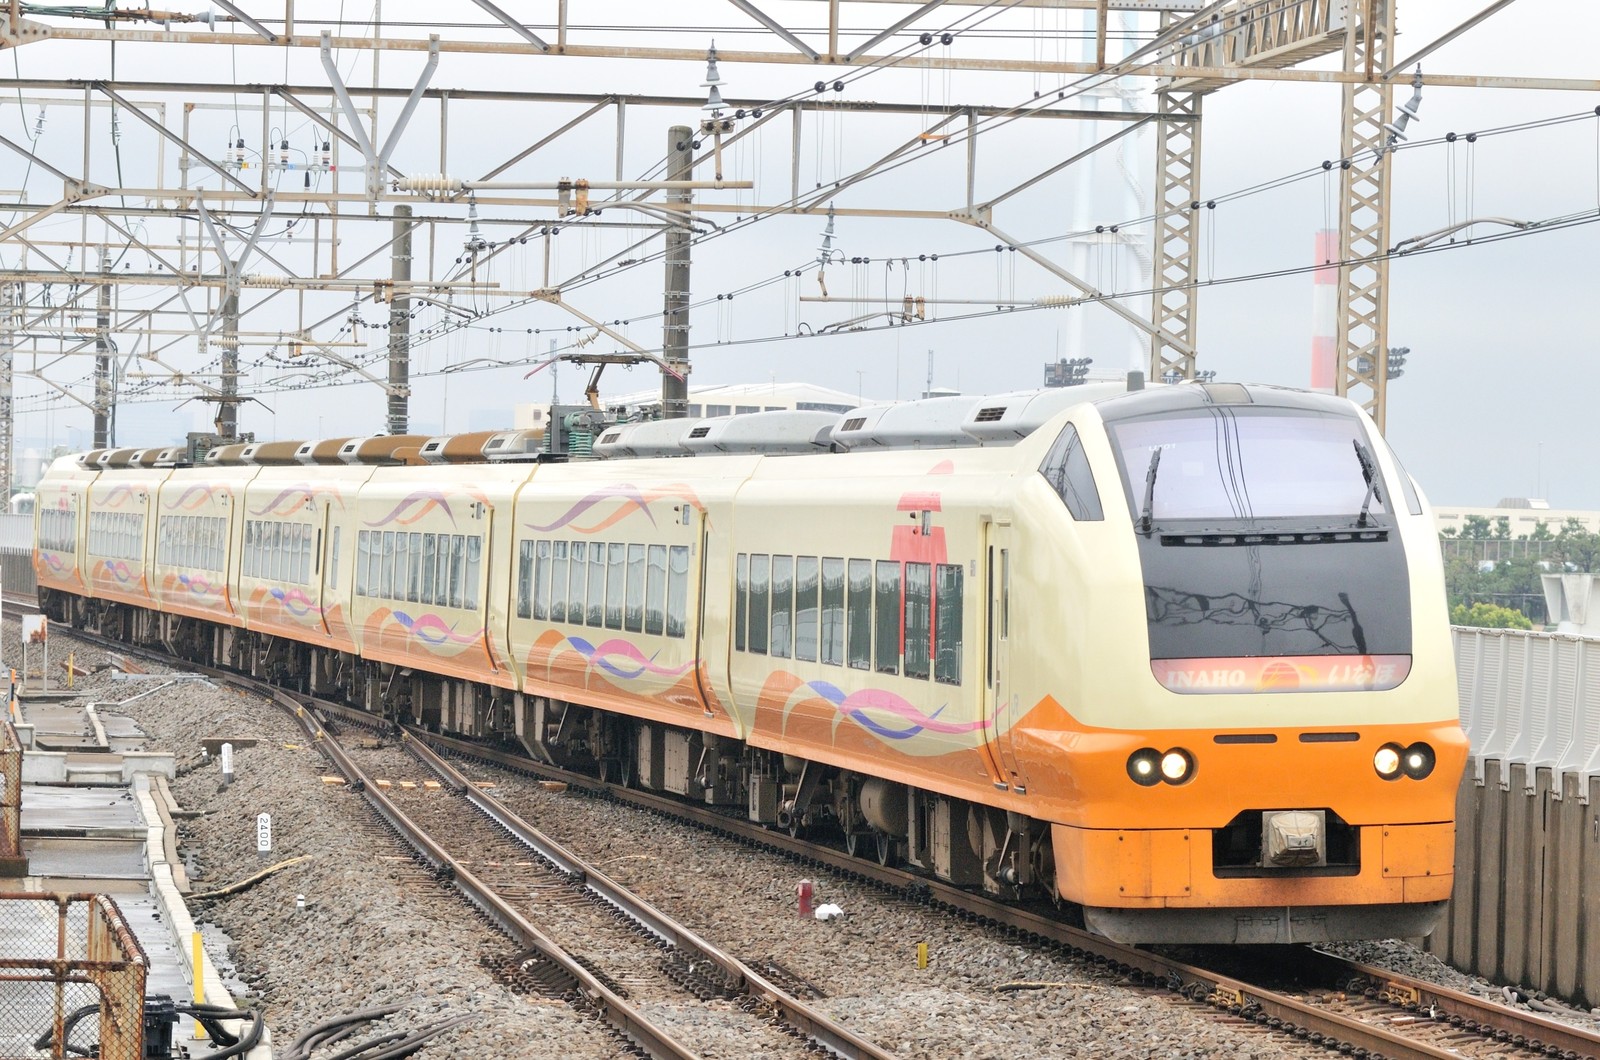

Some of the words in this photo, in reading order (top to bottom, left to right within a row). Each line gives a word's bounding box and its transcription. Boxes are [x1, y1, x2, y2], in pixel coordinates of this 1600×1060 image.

[1166, 670, 1246, 687] INAHO
[1328, 664, 1397, 685] いなほ
[260, 817, 269, 847] 2400
